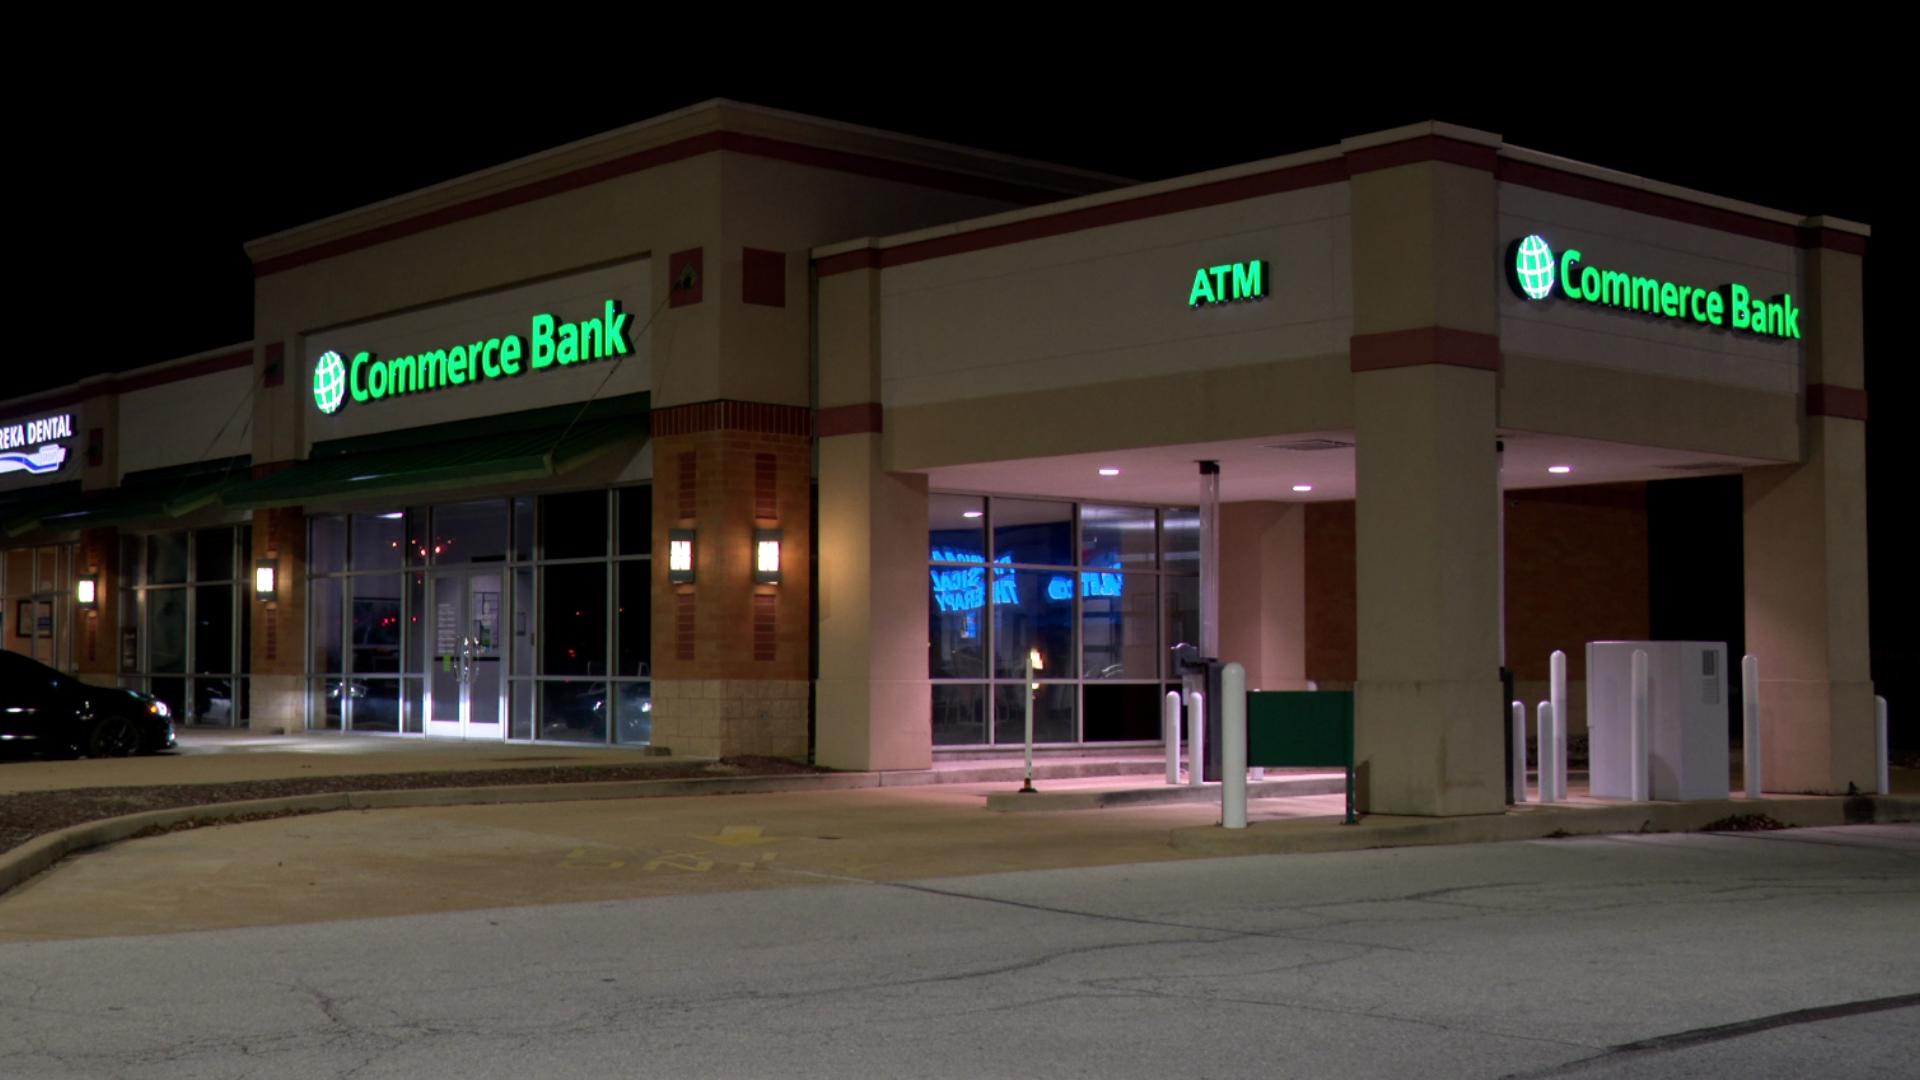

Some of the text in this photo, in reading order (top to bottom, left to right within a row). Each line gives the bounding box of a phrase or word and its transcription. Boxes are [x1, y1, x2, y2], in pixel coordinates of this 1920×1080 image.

[1189, 260, 1264, 307] ATM
[1560, 249, 1802, 340] Commerce Bank
[349, 299, 629, 403] Commerce Bank
[28, 414, 72, 445] DENTAL
